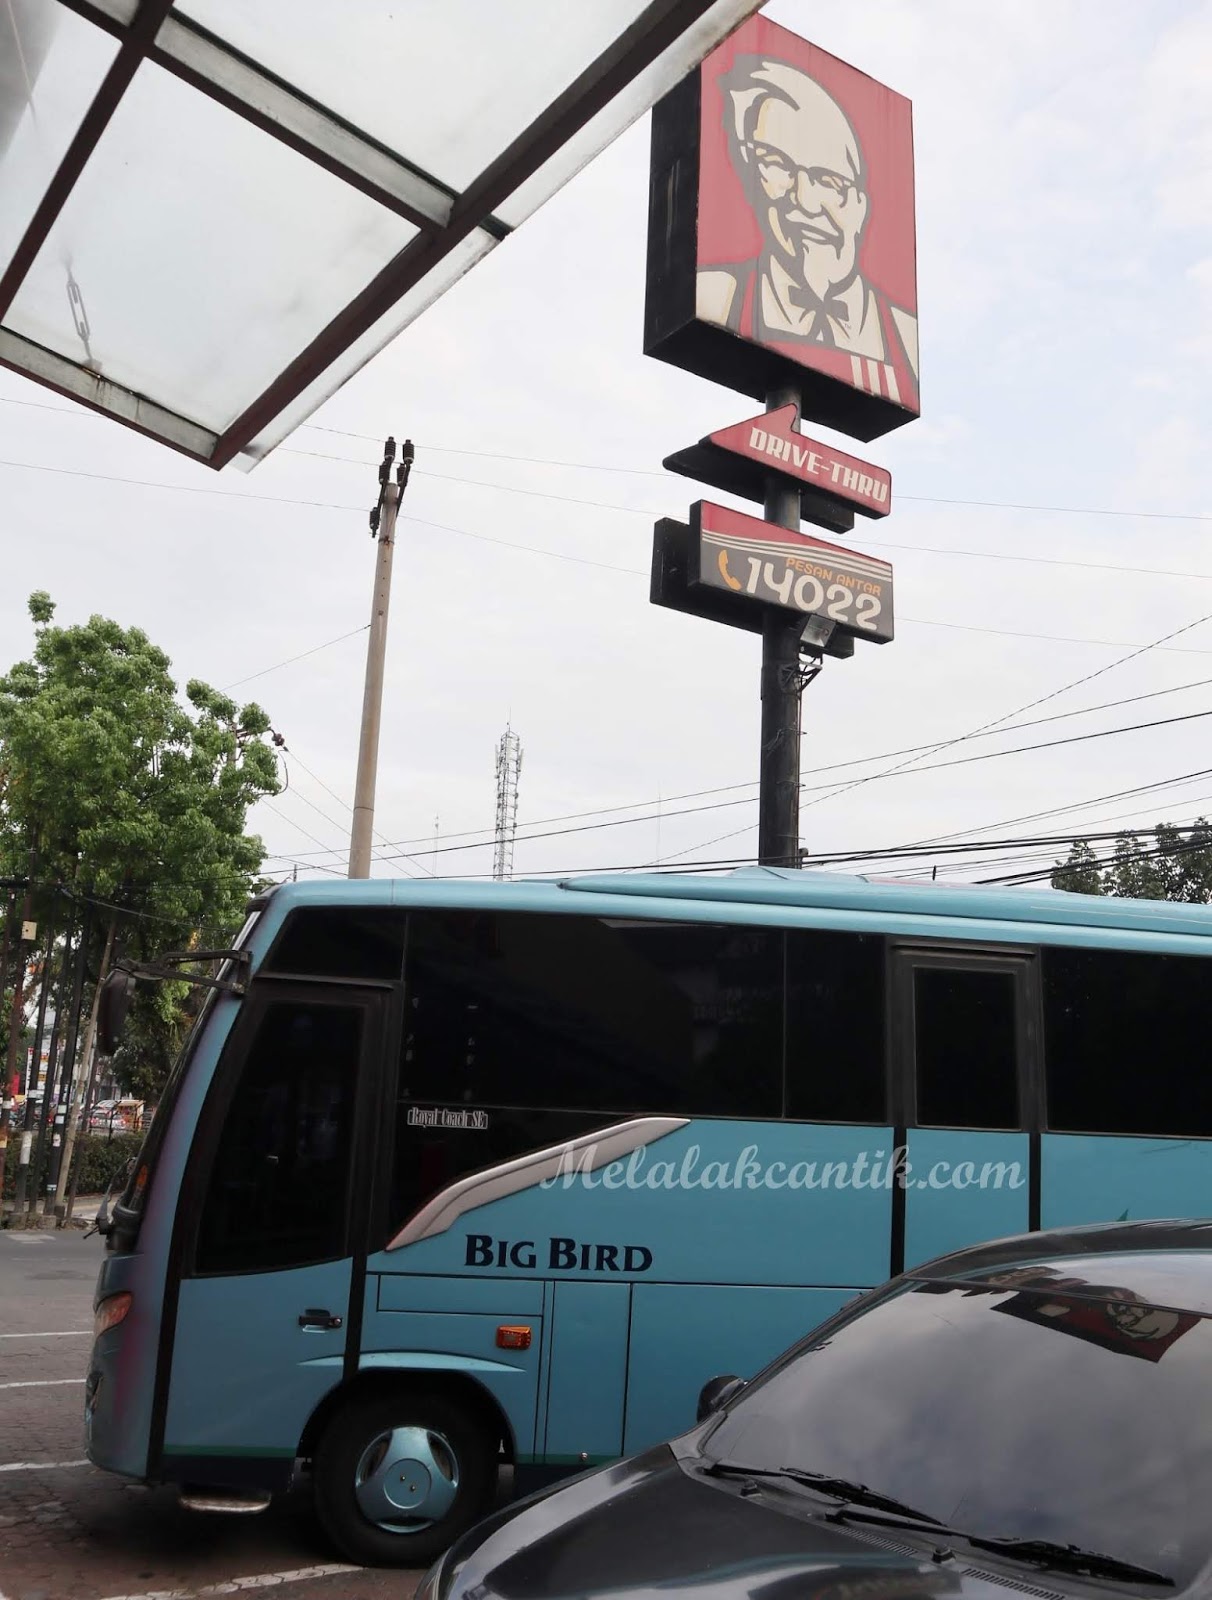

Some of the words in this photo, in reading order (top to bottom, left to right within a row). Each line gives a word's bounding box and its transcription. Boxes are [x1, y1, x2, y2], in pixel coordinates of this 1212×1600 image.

[749, 426, 888, 503] DRIVE-THRU
[746, 556, 882, 631] 14022
[785, 557, 833, 582] PESAN
[836, 574, 882, 597] ANTAR
[411, 1106, 439, 1128] Royal
[441, 1108, 469, 1127] Coach
[471, 1110, 485, 1128] SE
[464, 1234, 537, 1269] BIG
[547, 1237, 653, 1272] BIRD
